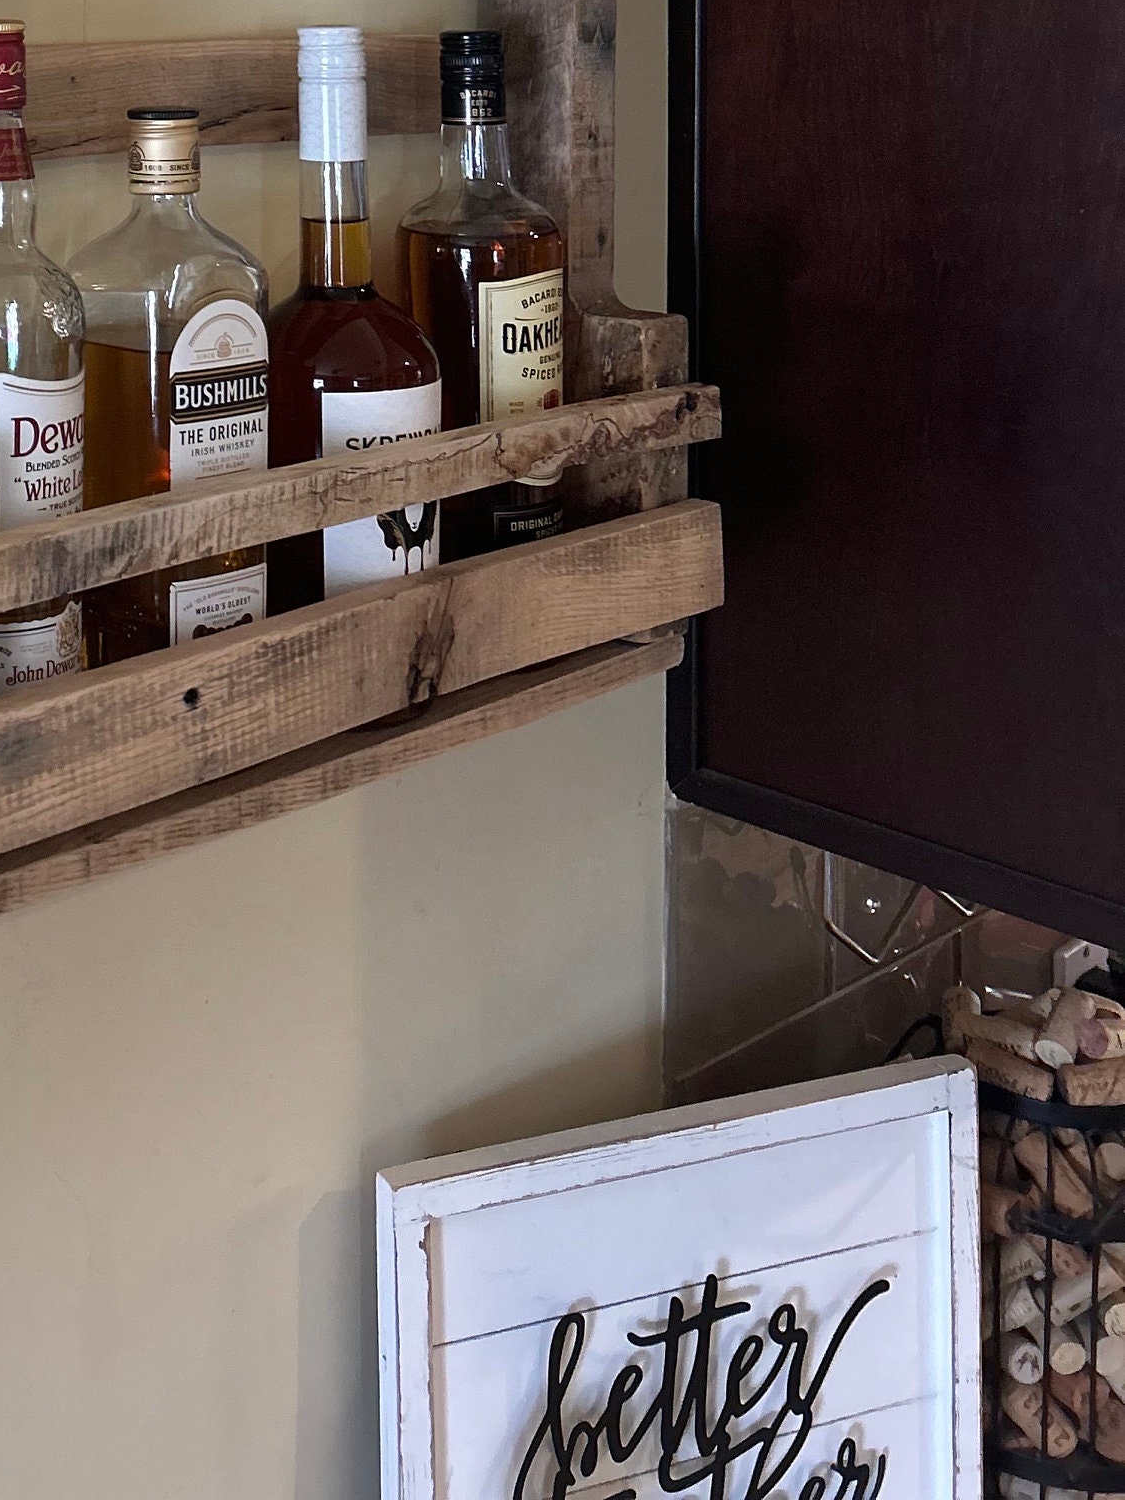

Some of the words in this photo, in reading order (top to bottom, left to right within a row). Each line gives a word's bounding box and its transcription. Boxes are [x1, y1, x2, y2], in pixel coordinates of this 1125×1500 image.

[521, 366, 556, 381] SPICED
[175, 373, 268, 410] BUSHMILLS
[179, 428, 204, 446] THE
[209, 417, 264, 442] ORIGINAL
[191, 446, 215, 457] IRISH
[218, 438, 255, 453] WHISKEY
[25, 459, 61, 473] BLENDED
[510, 515, 553, 532] ORIGINAL
[195, 603, 226, 615] WORLD'S
[227, 596, 252, 609] OLDEST
[5, 665, 44, 687] John
[513, 1274, 890, 1500] better
